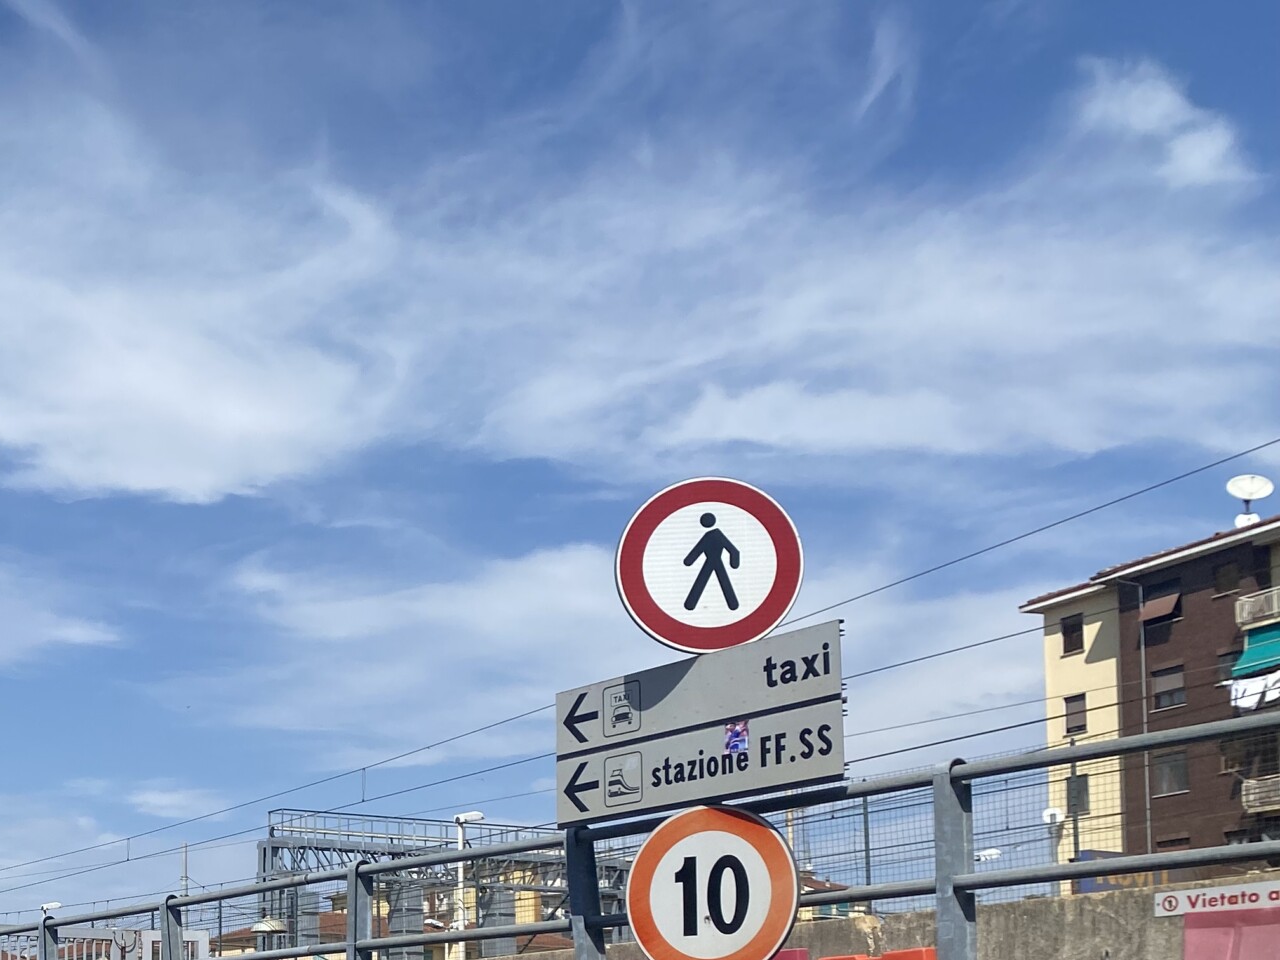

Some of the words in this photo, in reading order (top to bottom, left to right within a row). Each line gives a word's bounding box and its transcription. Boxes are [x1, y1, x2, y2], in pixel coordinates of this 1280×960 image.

[763, 643, 831, 687] taxi
[651, 750, 749, 787] stazione
[760, 724, 833, 768] FF.SS
[675, 854, 750, 937] 10
[1187, 892, 1260, 909] Vietato
